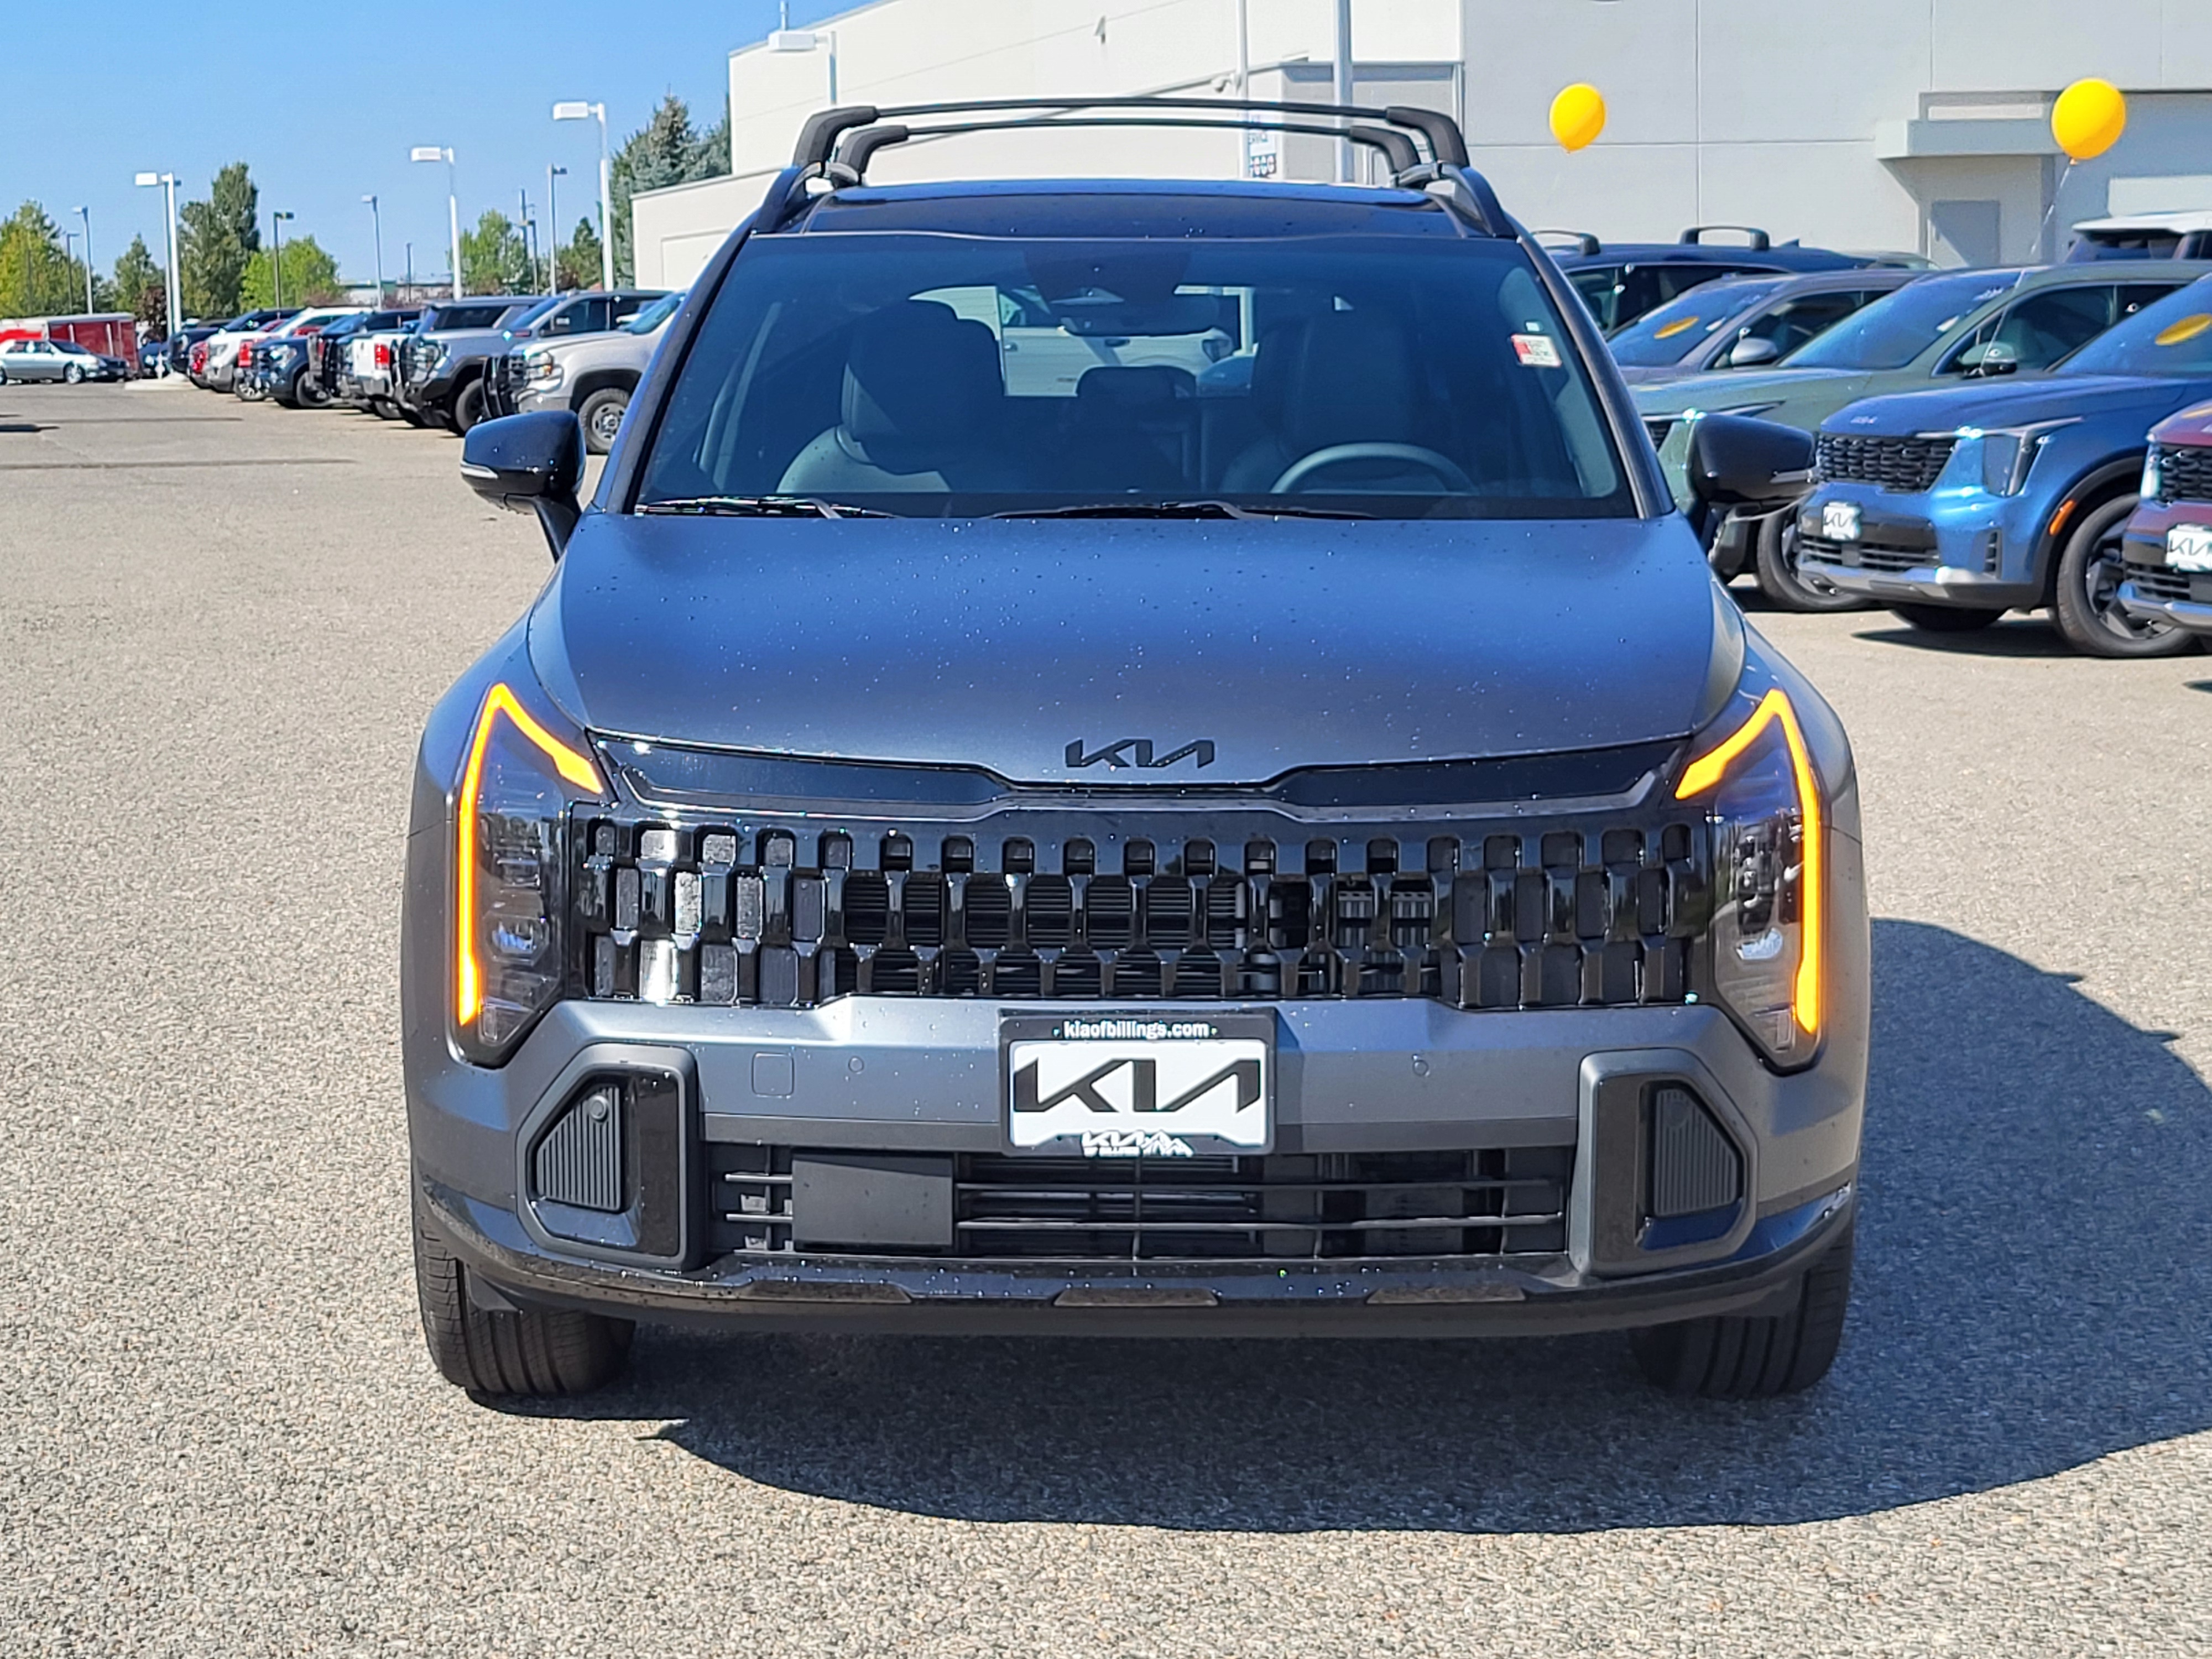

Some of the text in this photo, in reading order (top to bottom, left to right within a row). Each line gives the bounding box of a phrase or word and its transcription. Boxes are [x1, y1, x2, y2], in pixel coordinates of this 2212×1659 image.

[1065, 739, 1214, 768] KIA
[1063, 1021, 1209, 1039] kiaofbillings.com
[1014, 1057, 1261, 1114] KIA
[1082, 1130, 1145, 1146] KIA
